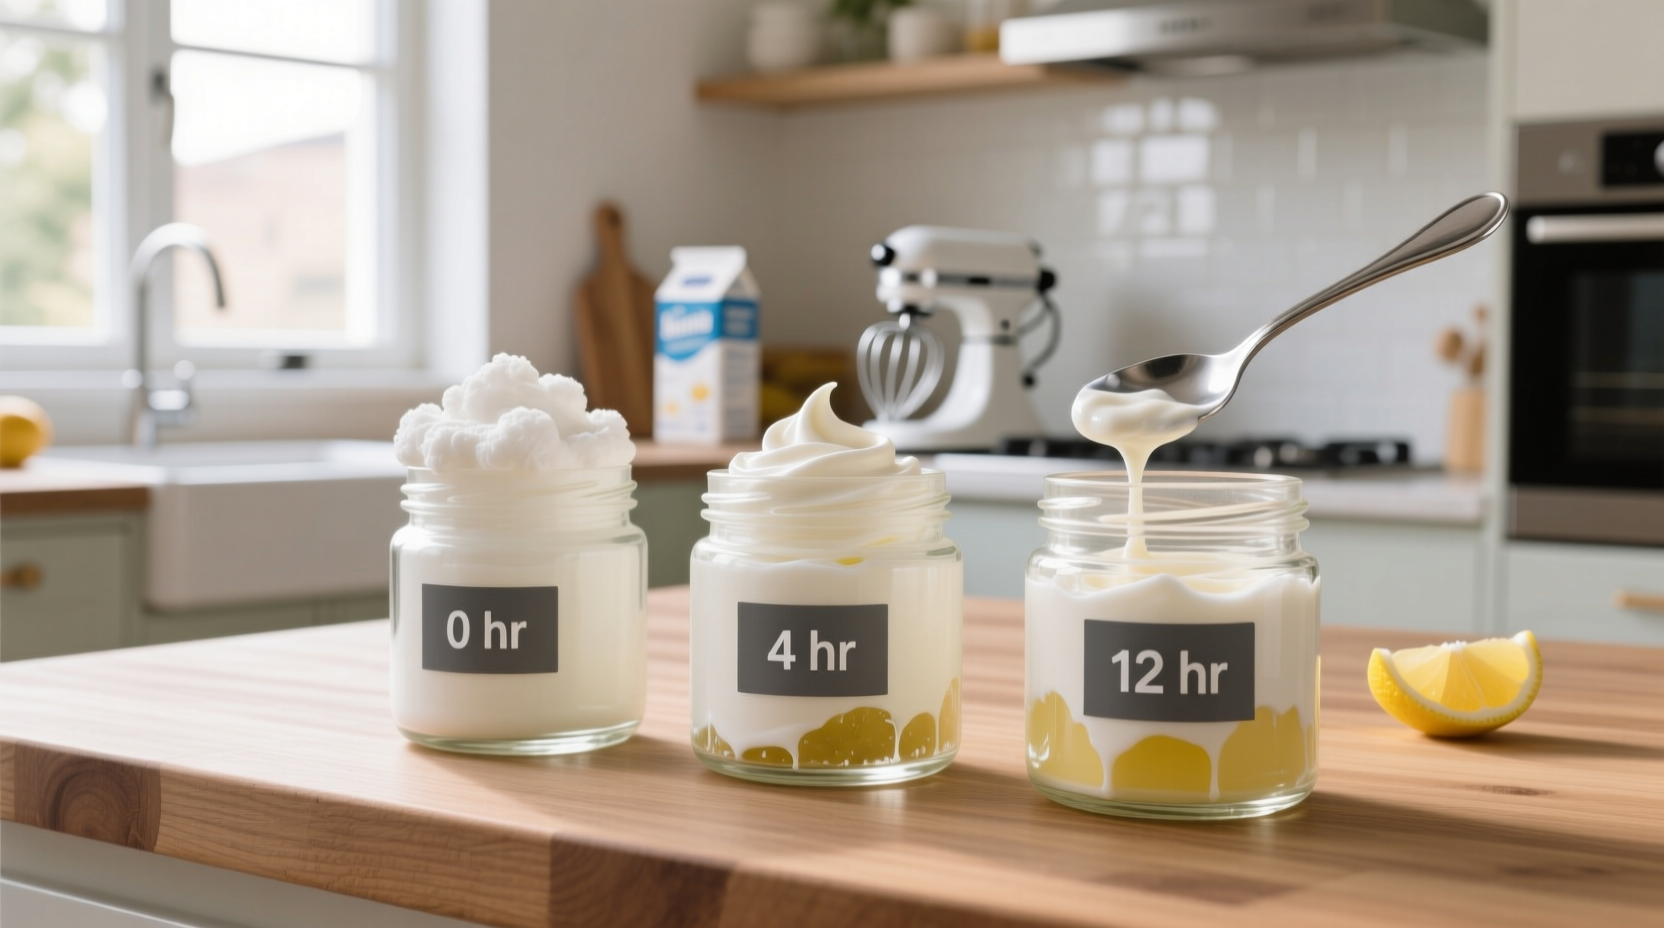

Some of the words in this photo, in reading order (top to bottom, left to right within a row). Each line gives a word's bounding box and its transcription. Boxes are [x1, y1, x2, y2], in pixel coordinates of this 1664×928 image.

[446, 609, 471, 650] 0
[484, 610, 527, 650] hr
[767, 629, 796, 671] 4
[810, 629, 857, 671] hr
[1111, 649, 1164, 694] 12
[1180, 650, 1228, 694] hr
